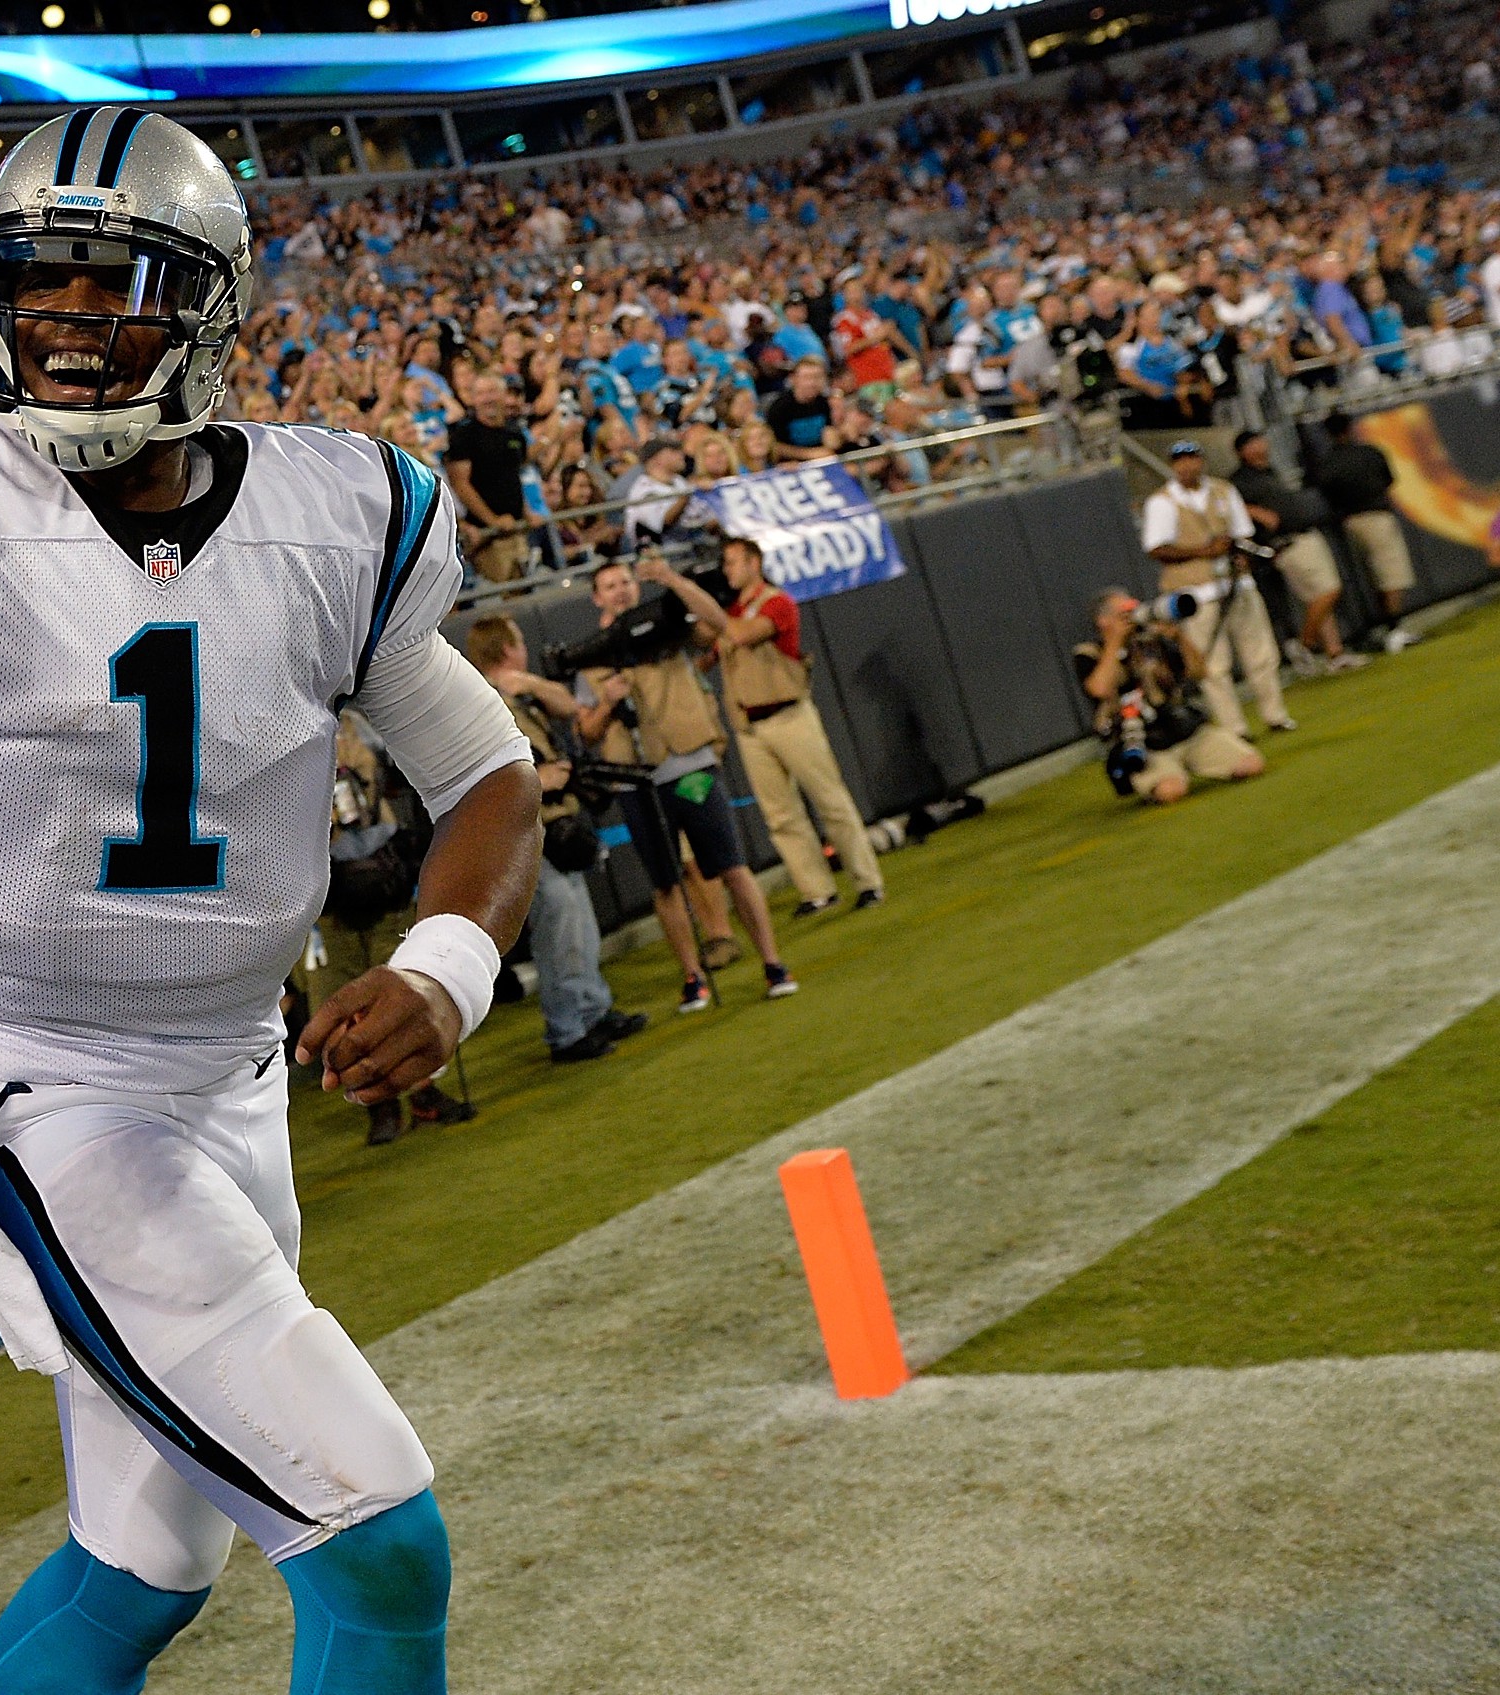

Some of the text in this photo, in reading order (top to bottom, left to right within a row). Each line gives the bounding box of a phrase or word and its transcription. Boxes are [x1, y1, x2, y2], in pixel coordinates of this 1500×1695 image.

[56, 194, 106, 207] PANTHERS
[719, 468, 847, 526] FREE
[150, 560, 177, 579] NFL
[94, 621, 228, 894] 1
